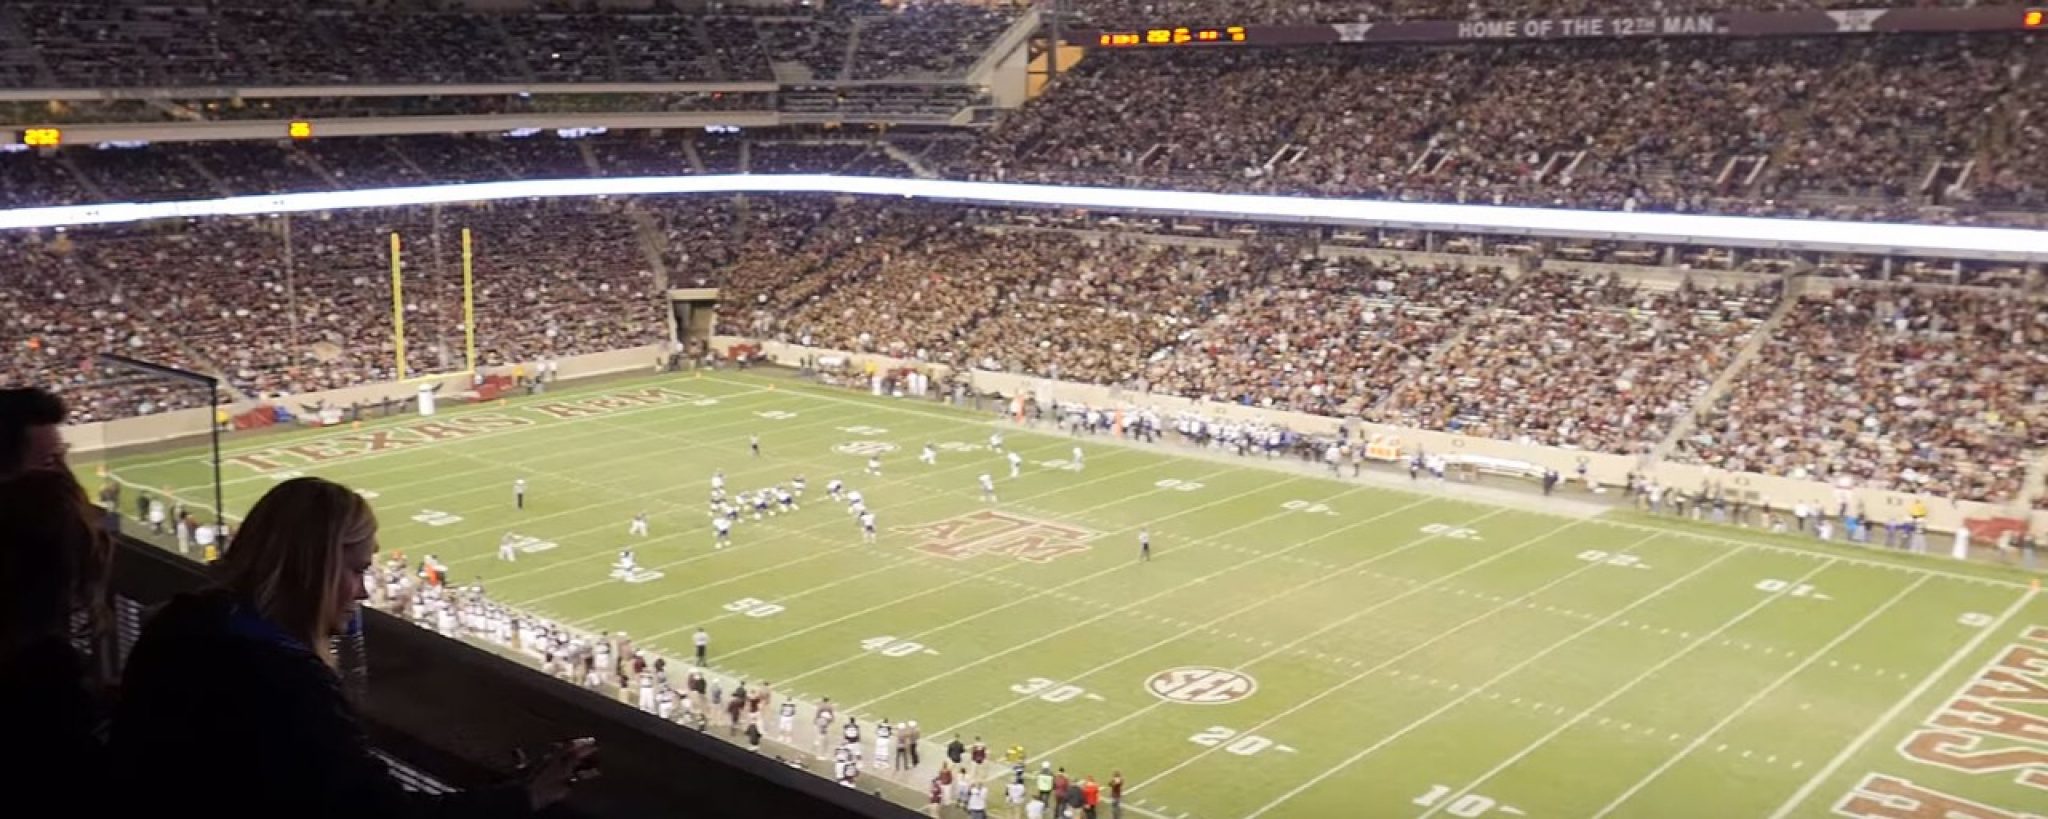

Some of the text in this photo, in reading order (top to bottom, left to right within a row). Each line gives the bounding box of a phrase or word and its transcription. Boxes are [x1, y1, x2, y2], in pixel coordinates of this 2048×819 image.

[1458, 20, 1518, 38] HOME
[1524, 20, 1553, 37] OF
[1562, 18, 1603, 36] THE
[1662, 15, 1714, 33] MAN
[228, 412, 535, 473] TEXAS
[721, 597, 786, 618] 50
[860, 635, 925, 658] 40
[1010, 677, 1085, 703] 30
[1150, 668, 1252, 701] SEC
[1187, 725, 1274, 756] 20
[1412, 783, 1497, 818] 10
